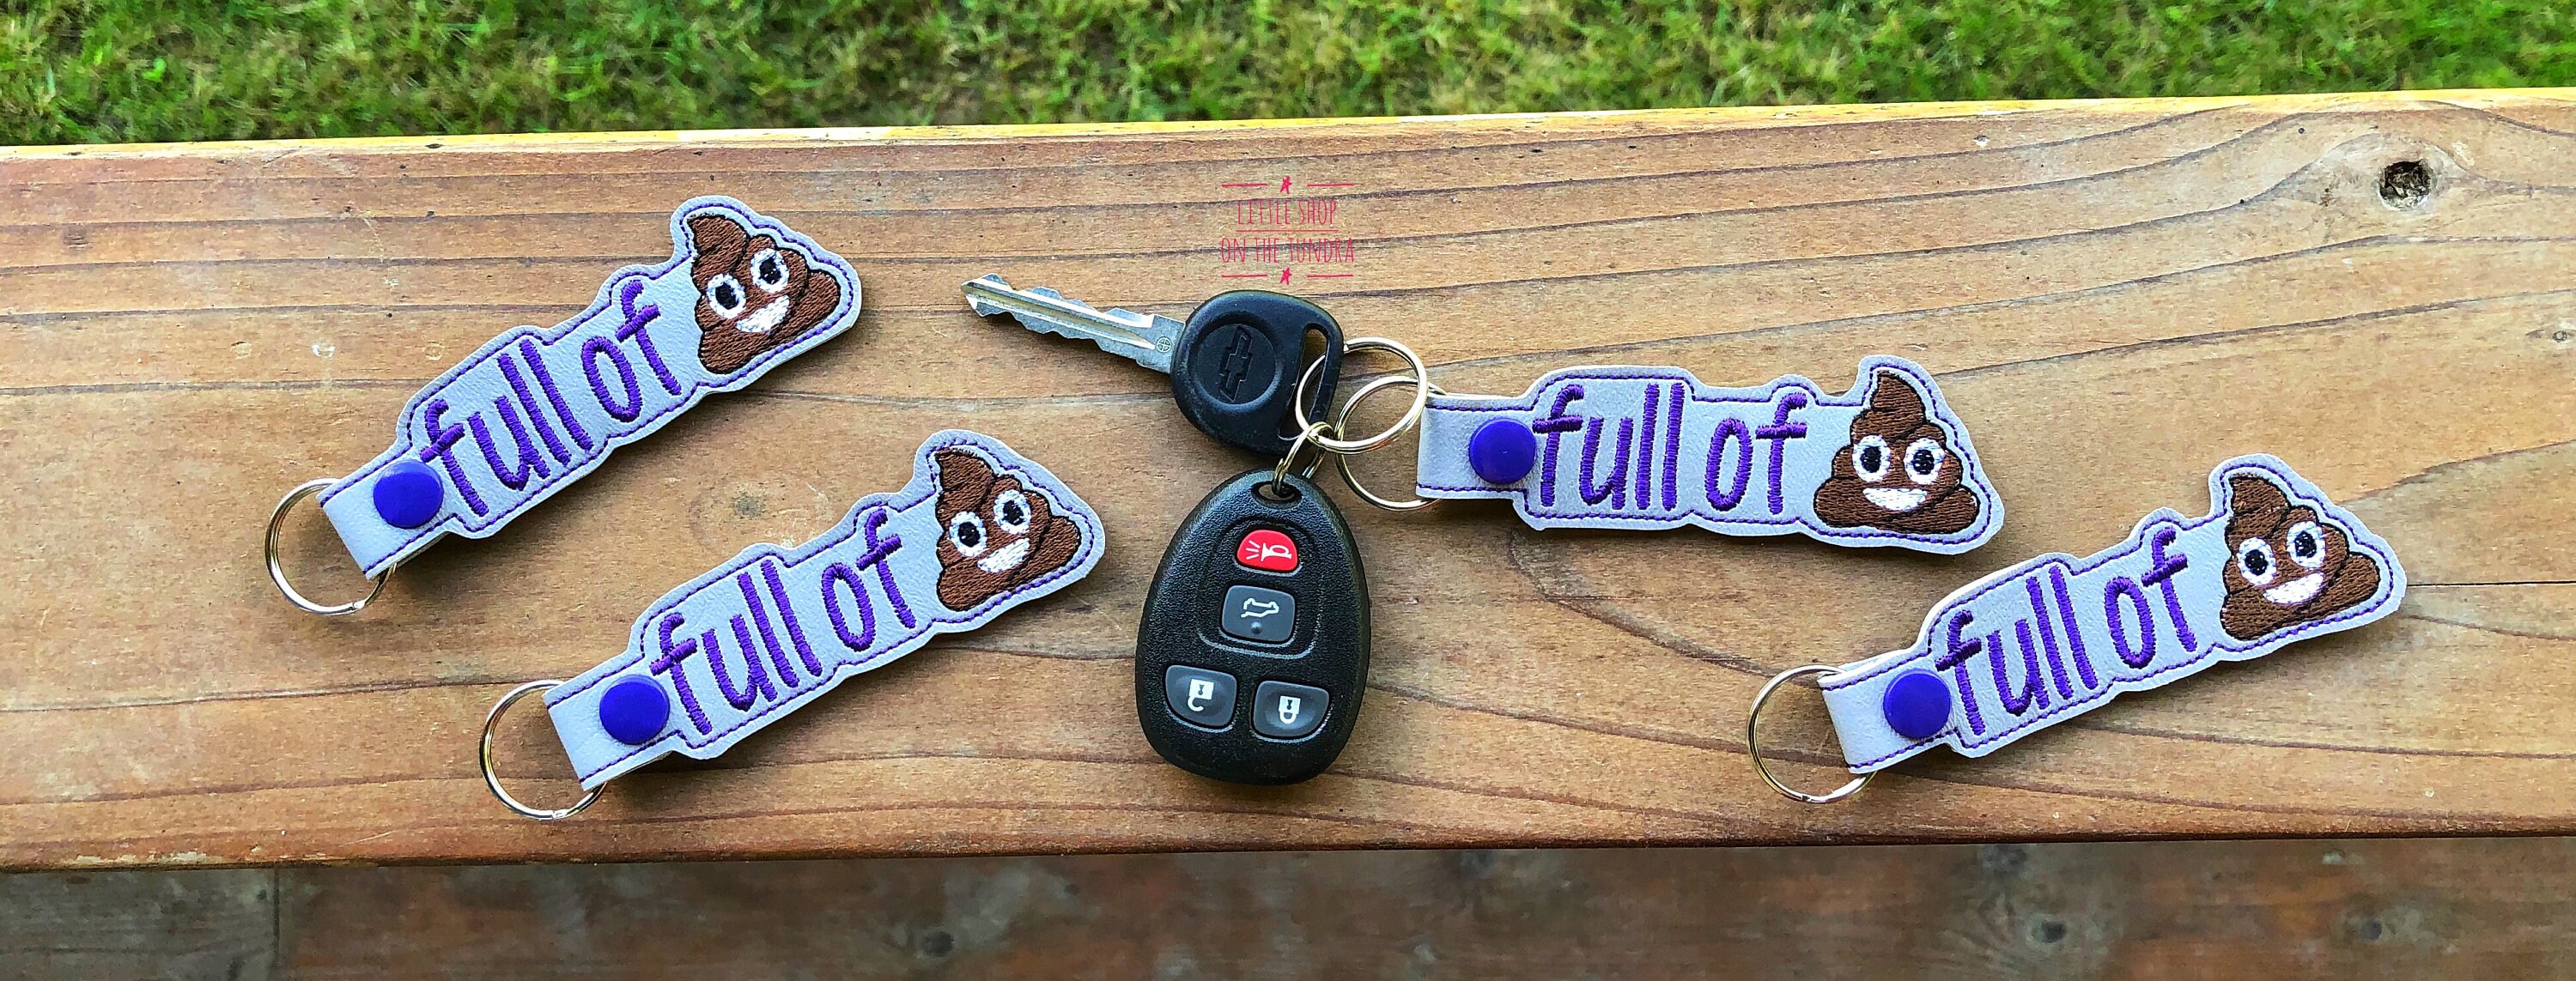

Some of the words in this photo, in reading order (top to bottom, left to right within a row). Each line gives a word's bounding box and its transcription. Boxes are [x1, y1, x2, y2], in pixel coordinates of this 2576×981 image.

[419, 338, 595, 517] full
[581, 279, 682, 422] of
[1532, 383, 1685, 511] full
[1704, 392, 1807, 515] of
[648, 560, 823, 736] full
[821, 507, 918, 652] of
[1935, 565, 2099, 736] full
[2104, 526, 2198, 669] of
